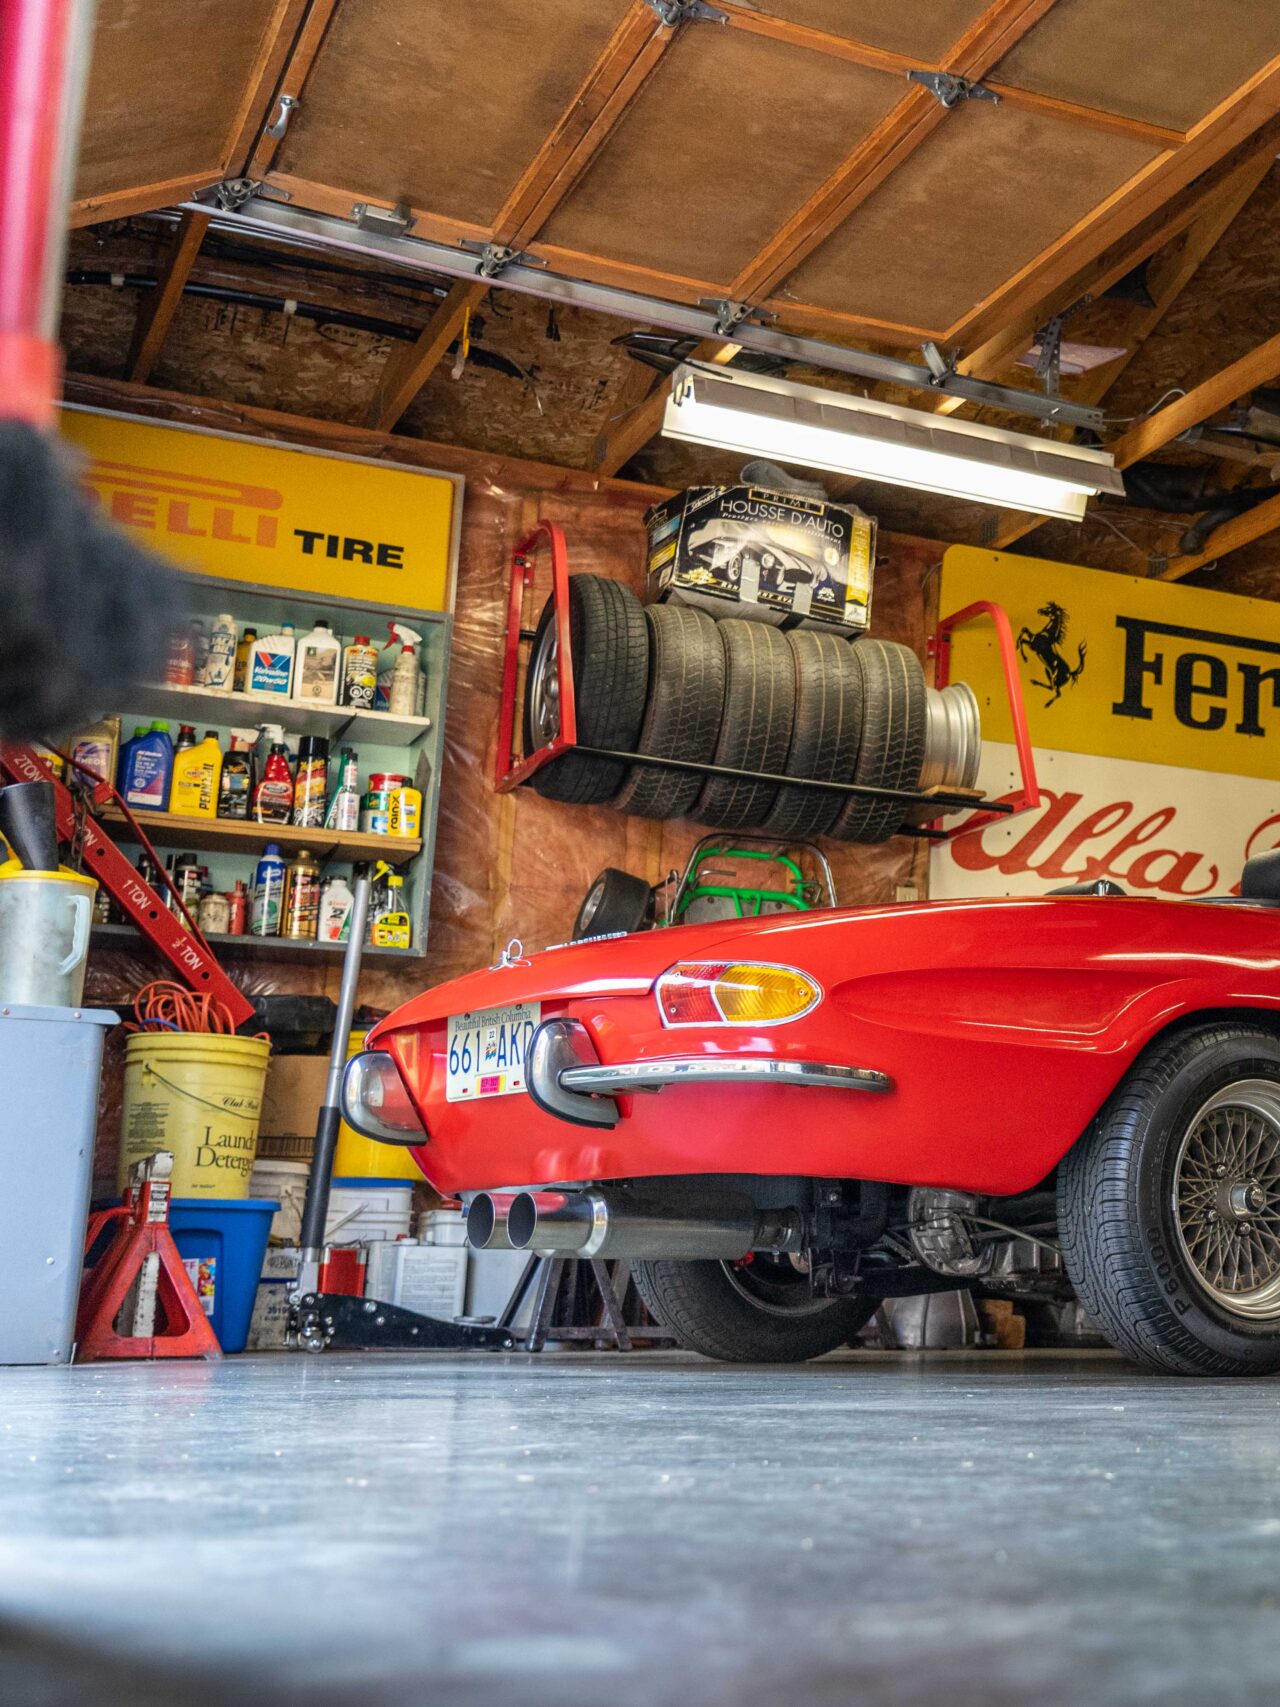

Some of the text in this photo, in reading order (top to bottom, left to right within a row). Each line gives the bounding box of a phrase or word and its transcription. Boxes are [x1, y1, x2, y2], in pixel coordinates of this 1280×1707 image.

[80, 460, 405, 569] ELLI TIRE
[762, 491, 812, 511] PRIME
[719, 499, 786, 523] HOUSSE
[790, 510, 844, 538] D'AUTO
[199, 763, 214, 811] PENNZIL
[949, 788, 1219, 896] Alfa
[127, 885, 152, 910] TON
[180, 945, 204, 971] TON
[455, 1008, 532, 1032] Beautiful British Columbia
[449, 1030, 481, 1076] 661
[203, 1126, 257, 1151] Laund
